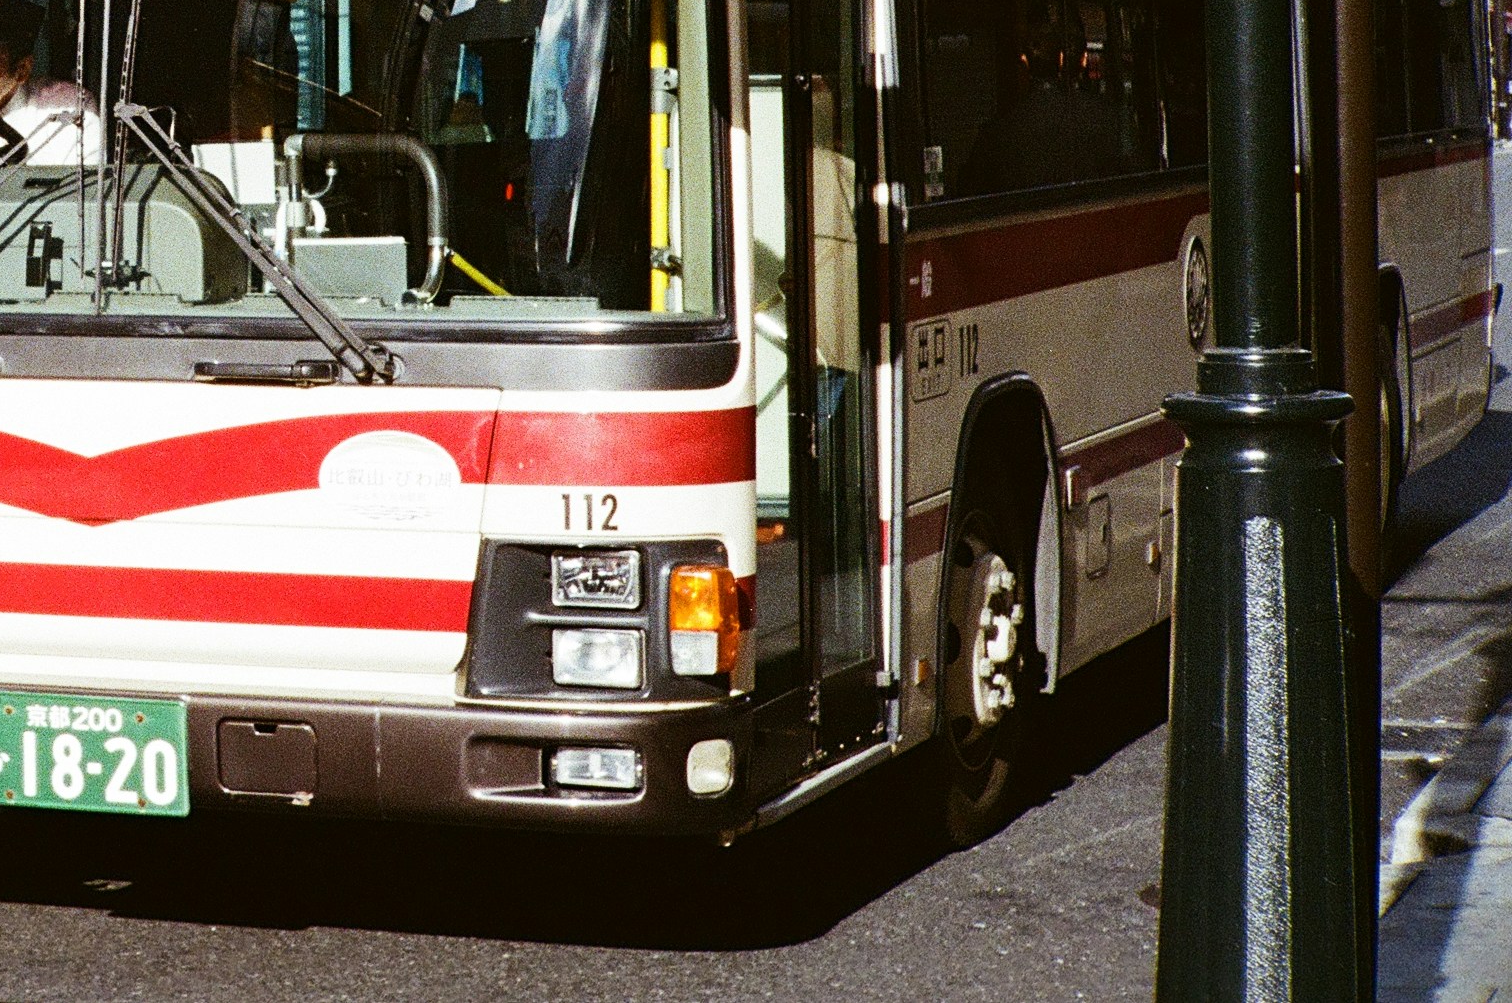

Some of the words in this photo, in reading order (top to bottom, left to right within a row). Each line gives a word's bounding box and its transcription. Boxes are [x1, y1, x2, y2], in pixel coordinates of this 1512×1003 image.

[917, 325, 946, 372] 出口
[959, 323, 979, 377] 112
[561, 493, 619, 531] 112
[22, 730, 179, 806] 18-20
